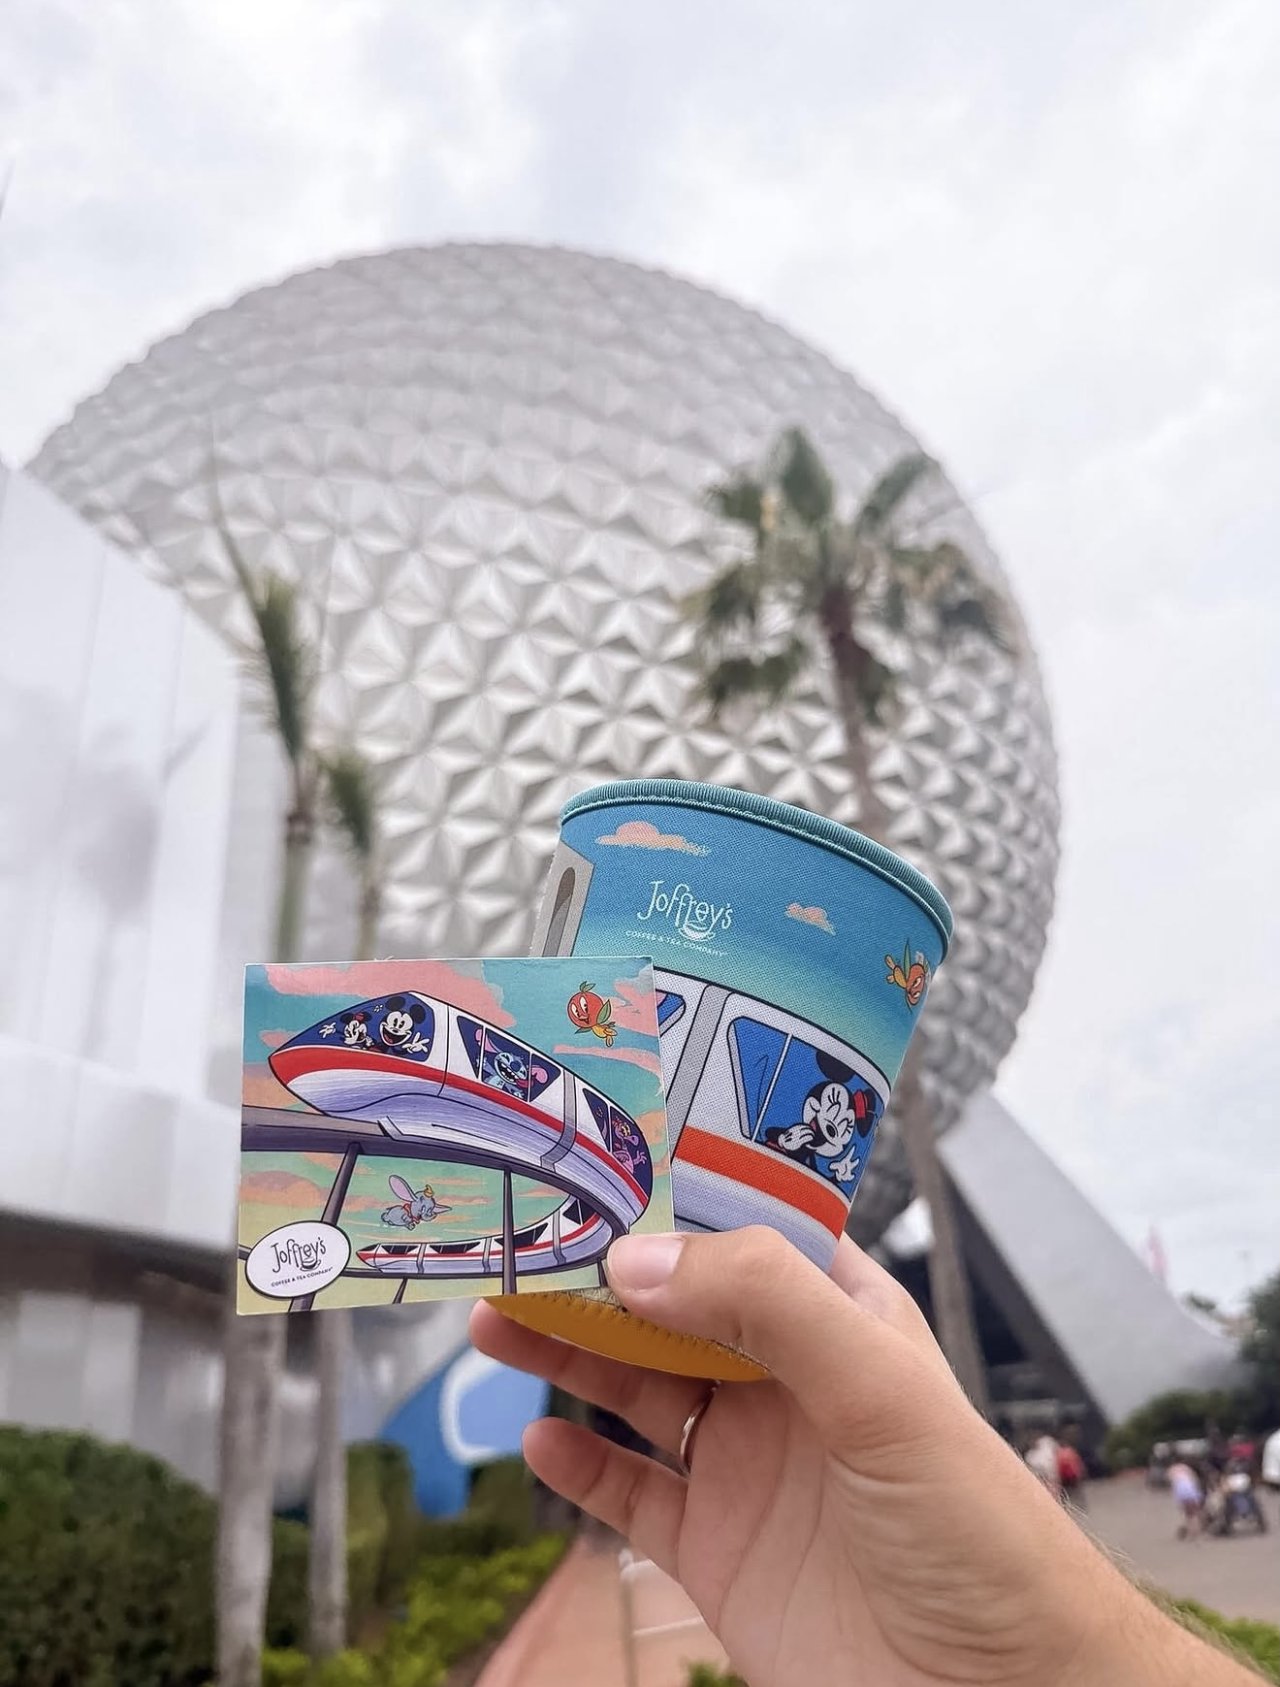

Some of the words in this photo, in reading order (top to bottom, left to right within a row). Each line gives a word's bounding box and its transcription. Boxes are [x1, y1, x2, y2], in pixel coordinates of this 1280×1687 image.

[637, 880, 733, 940] Joffrey's
[270, 1236, 327, 1273] Joffrey's
[271, 1278, 291, 1287] COFFEE
